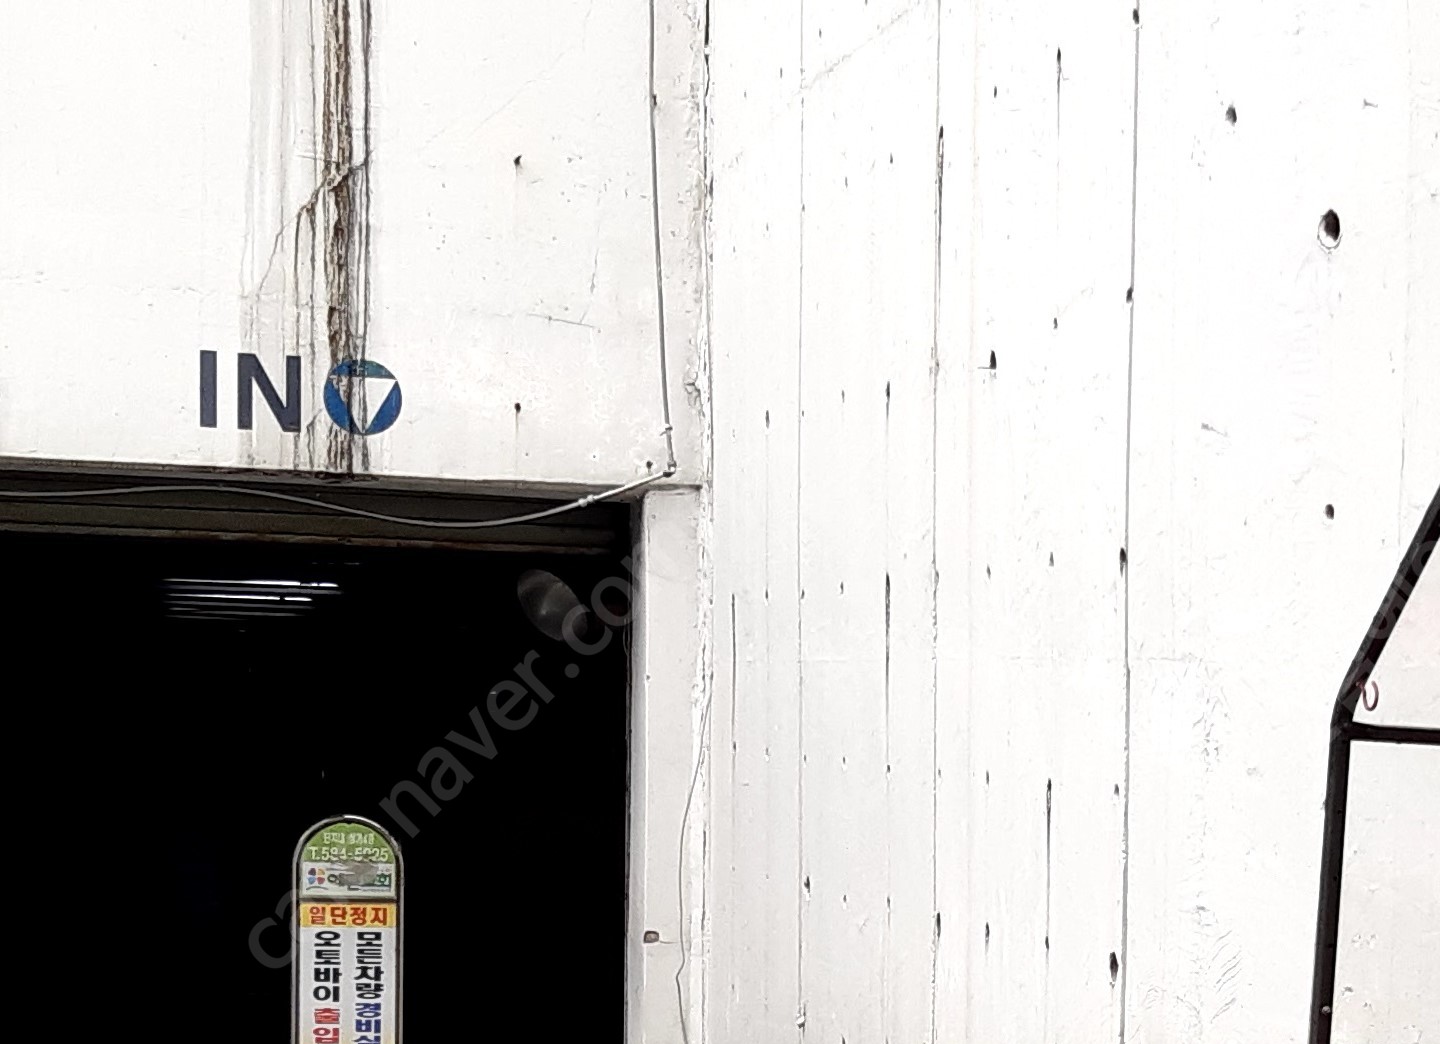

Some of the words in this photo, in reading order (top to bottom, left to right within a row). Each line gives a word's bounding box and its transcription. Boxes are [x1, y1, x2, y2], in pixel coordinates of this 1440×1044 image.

[199, 349, 302, 433] IN
[309, 906, 388, 926] 일단정지
[313, 930, 342, 1002] 오토바이
